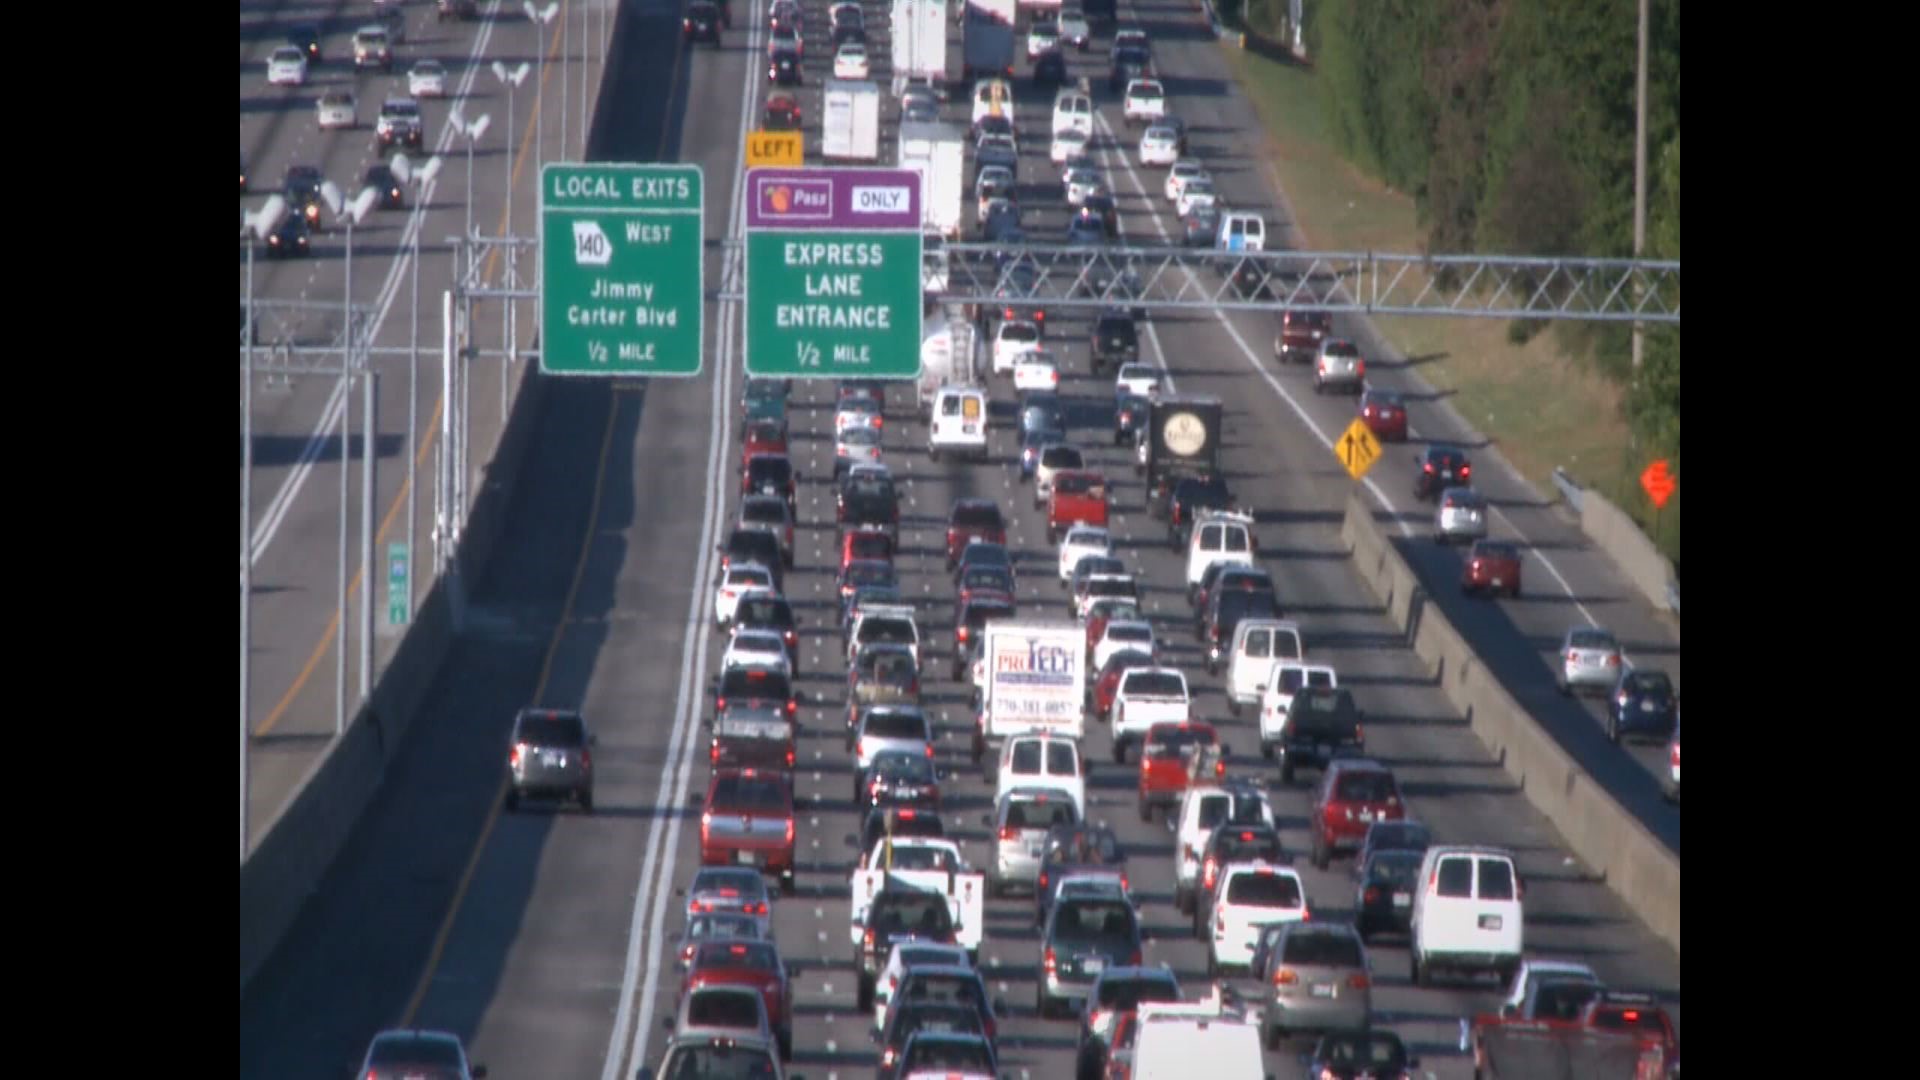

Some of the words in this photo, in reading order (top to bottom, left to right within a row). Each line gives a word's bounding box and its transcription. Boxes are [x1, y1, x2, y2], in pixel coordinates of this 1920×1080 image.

[752, 139, 794, 158] LEFT
[554, 176, 620, 198] LOCAL
[632, 177, 689, 199] EXITS
[793, 189, 827, 206] Pass
[860, 191, 901, 208] ONLY
[578, 234, 604, 257] 140
[784, 243, 883, 265] EXPRESS
[591, 280, 654, 300] Jimmy
[805, 275, 861, 296] LANE
[568, 306, 626, 326] Carter
[636, 306, 677, 326] Blvd
[777, 306, 890, 328] ENTRANCE
[619, 343, 655, 361] MILE
[833, 344, 870, 362] MILE
